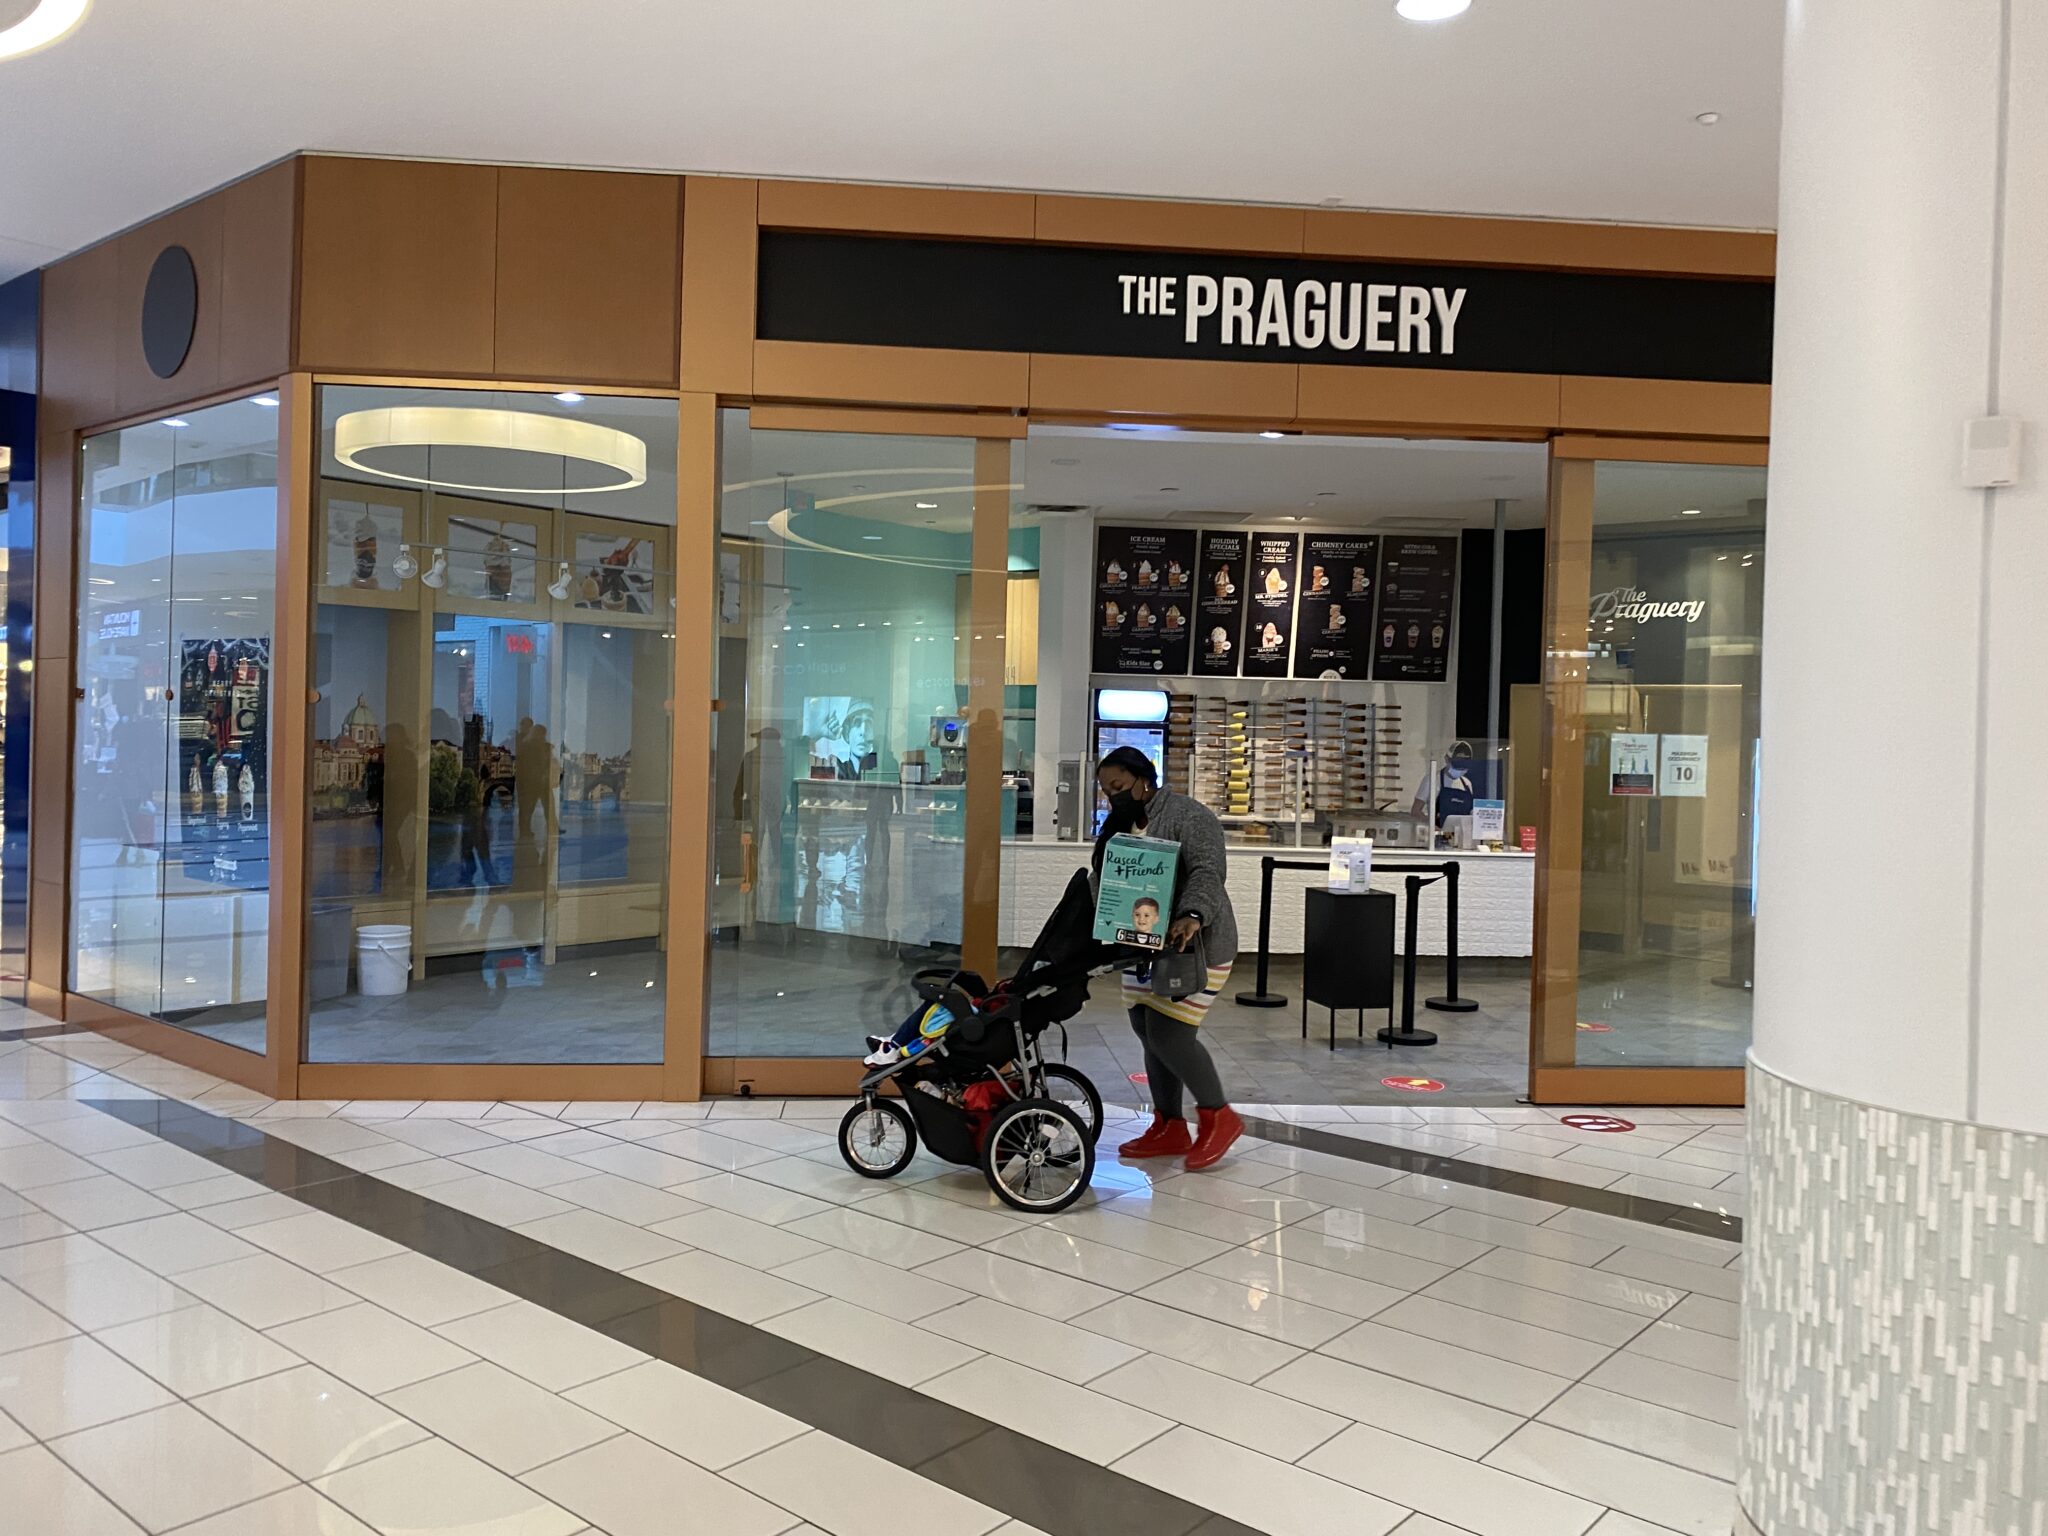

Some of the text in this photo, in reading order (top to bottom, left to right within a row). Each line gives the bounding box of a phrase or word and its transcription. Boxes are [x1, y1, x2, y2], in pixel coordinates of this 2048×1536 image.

[1118, 274, 1468, 355] THE PRAGUERY
[1311, 541, 1344, 549] CHIMNEY
[1617, 585, 1647, 602] The
[1590, 589, 1706, 624] Praguery
[1676, 767, 1693, 781] 10
[1106, 849, 1145, 867] Rascal
[1117, 930, 1125, 941] 6
